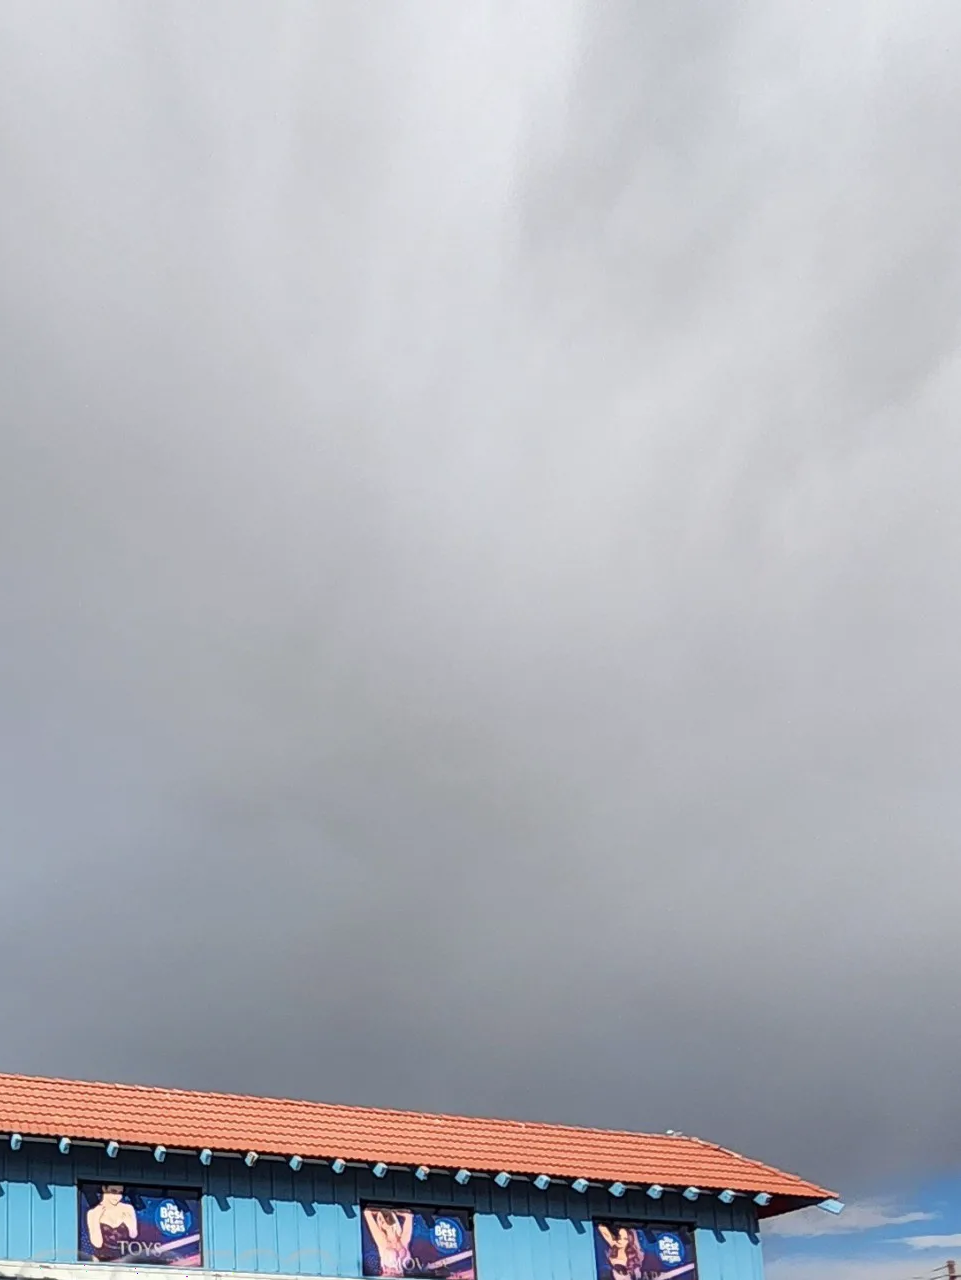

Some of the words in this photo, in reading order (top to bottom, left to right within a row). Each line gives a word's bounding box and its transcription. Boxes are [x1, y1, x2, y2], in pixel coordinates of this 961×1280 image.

[160, 1206, 184, 1219] Best
[159, 1220, 186, 1234] Vegas
[435, 1225, 456, 1237] Best
[117, 1240, 163, 1258] TOYS
